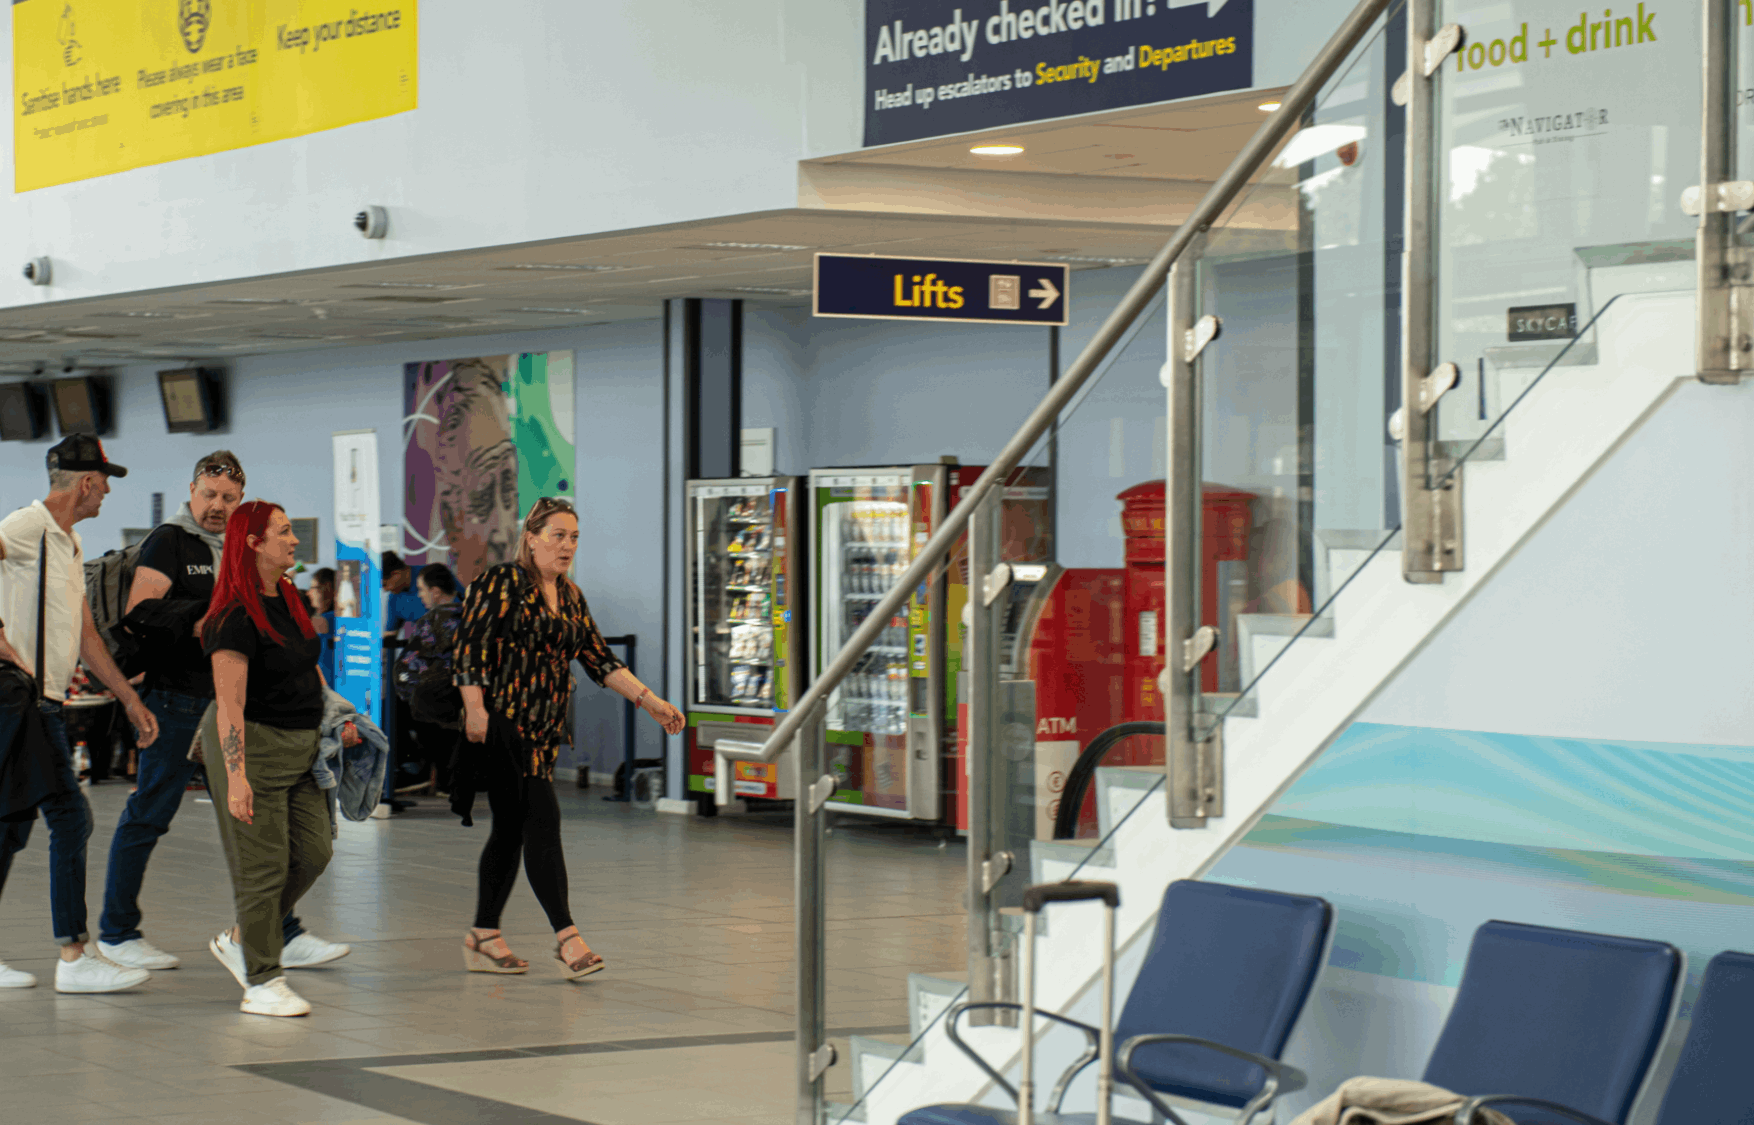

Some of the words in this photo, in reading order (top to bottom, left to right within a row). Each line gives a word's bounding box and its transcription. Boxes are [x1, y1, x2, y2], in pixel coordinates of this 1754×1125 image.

[276, 23, 311, 55] Keep
[312, 20, 343, 53] your
[344, 8, 402, 39] distance
[873, 9, 979, 64] Already
[985, 0, 1105, 45] checked
[1566, 2, 1658, 55] drink
[136, 68, 167, 90] Please
[202, 55, 226, 74] wear
[227, 54, 234, 70] a
[235, 44, 259, 66] face
[874, 87, 912, 111] Head
[915, 85, 935, 109] up
[937, 72, 1011, 101] escalators
[1014, 69, 1033, 88] to
[1035, 56, 1101, 86] Security
[1103, 46, 1135, 75] and
[1138, 36, 1236, 71] Departures
[21, 87, 61, 116] Sanitise
[61, 75, 95, 106] hands
[94, 71, 122, 97] here
[149, 91, 190, 119] covering
[190, 90, 202, 110] in
[202, 85, 222, 107] this
[221, 85, 245, 104] area
[893, 273, 965, 309] Lifts
[1035, 716, 1078, 735] ATM
